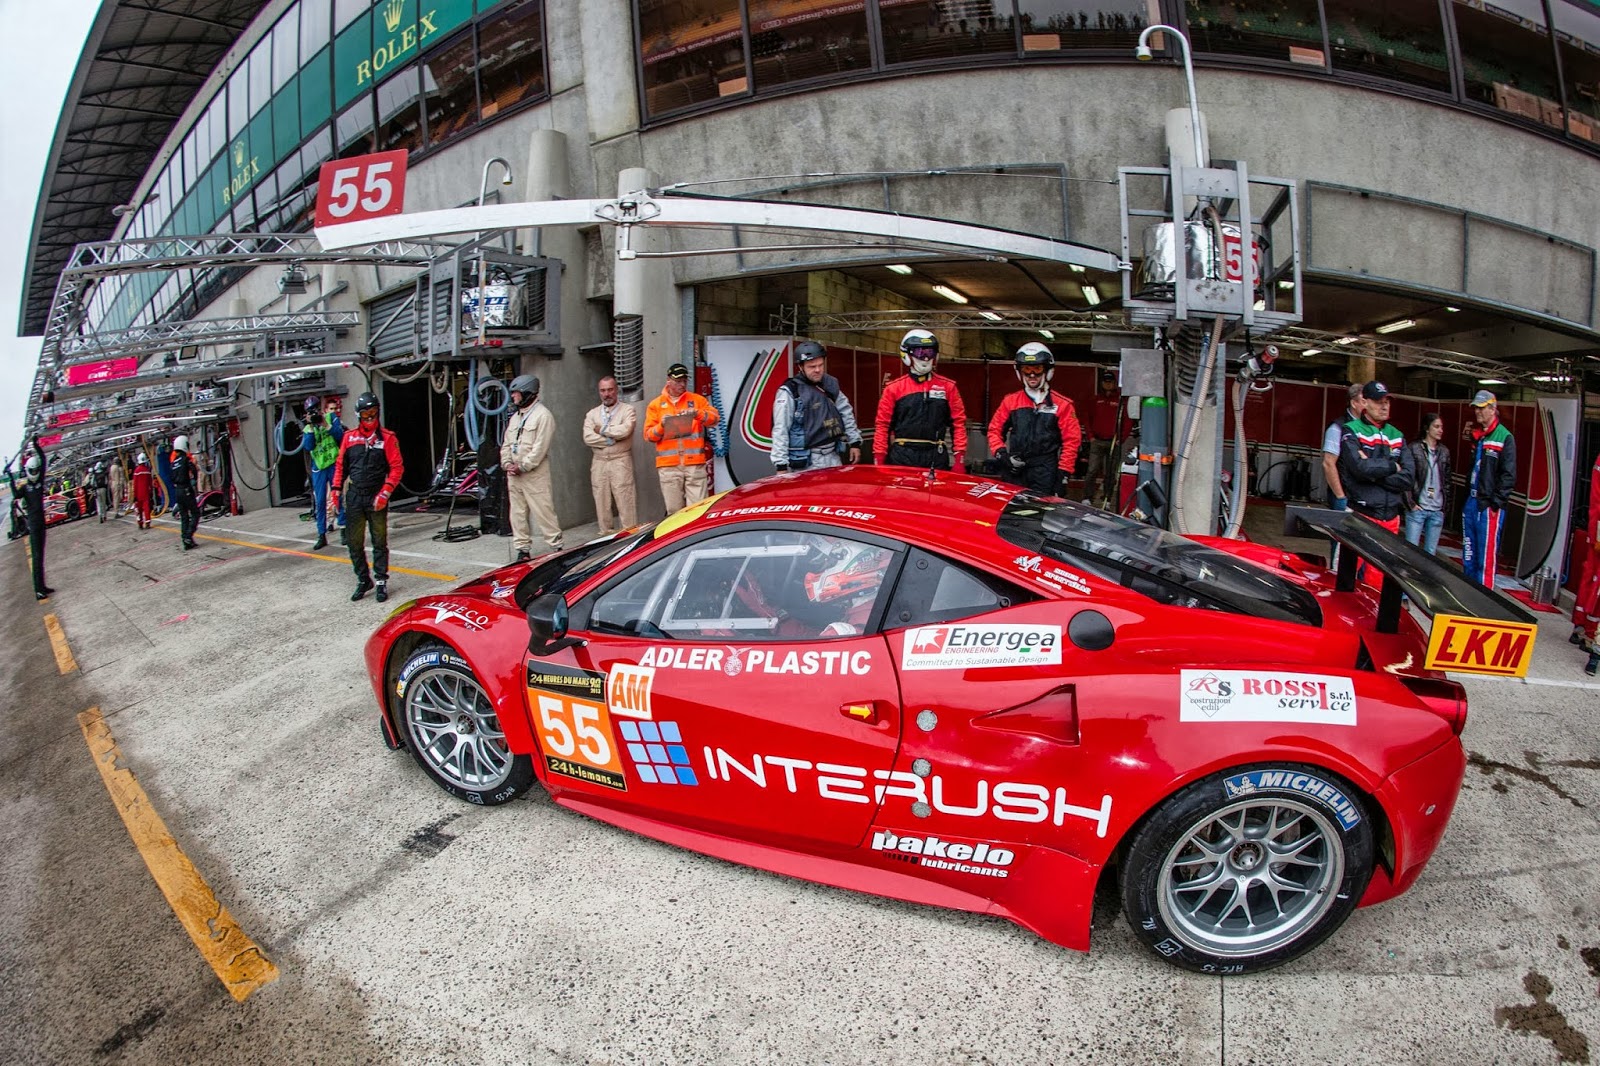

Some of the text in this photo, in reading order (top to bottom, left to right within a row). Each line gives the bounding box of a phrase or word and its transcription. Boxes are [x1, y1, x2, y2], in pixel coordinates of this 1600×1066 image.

[357, 10, 438, 86] ROLEX
[223, 156, 260, 205] ROLEX
[328, 161, 393, 218] 55
[720, 504, 803, 518] E.PERAZZINI
[945, 646, 1000, 655] ENGINEERING
[949, 627, 1056, 651] Energea
[1435, 626, 1530, 669] LKM
[403, 653, 438, 679] MICHELIN
[638, 646, 872, 676] ADLER PLASTIC
[906, 656, 1049, 667] Committed to Sustainable Design
[530, 673, 544, 684] 24
[543, 674, 563, 685] HEURES
[563, 676, 573, 685] DU
[572, 677, 590, 687] MANS
[611, 672, 650, 712] AM
[1242, 678, 1329, 710] ROSSI
[1190, 697, 1232, 705] costruzioni
[1201, 703, 1220, 712] edili
[537, 695, 612, 766] 55
[703, 745, 1113, 839] INTERUSH
[1259, 771, 1359, 825] MICHELIN
[871, 831, 1015, 866] pakelo
[920, 857, 1009, 878] lubricants
